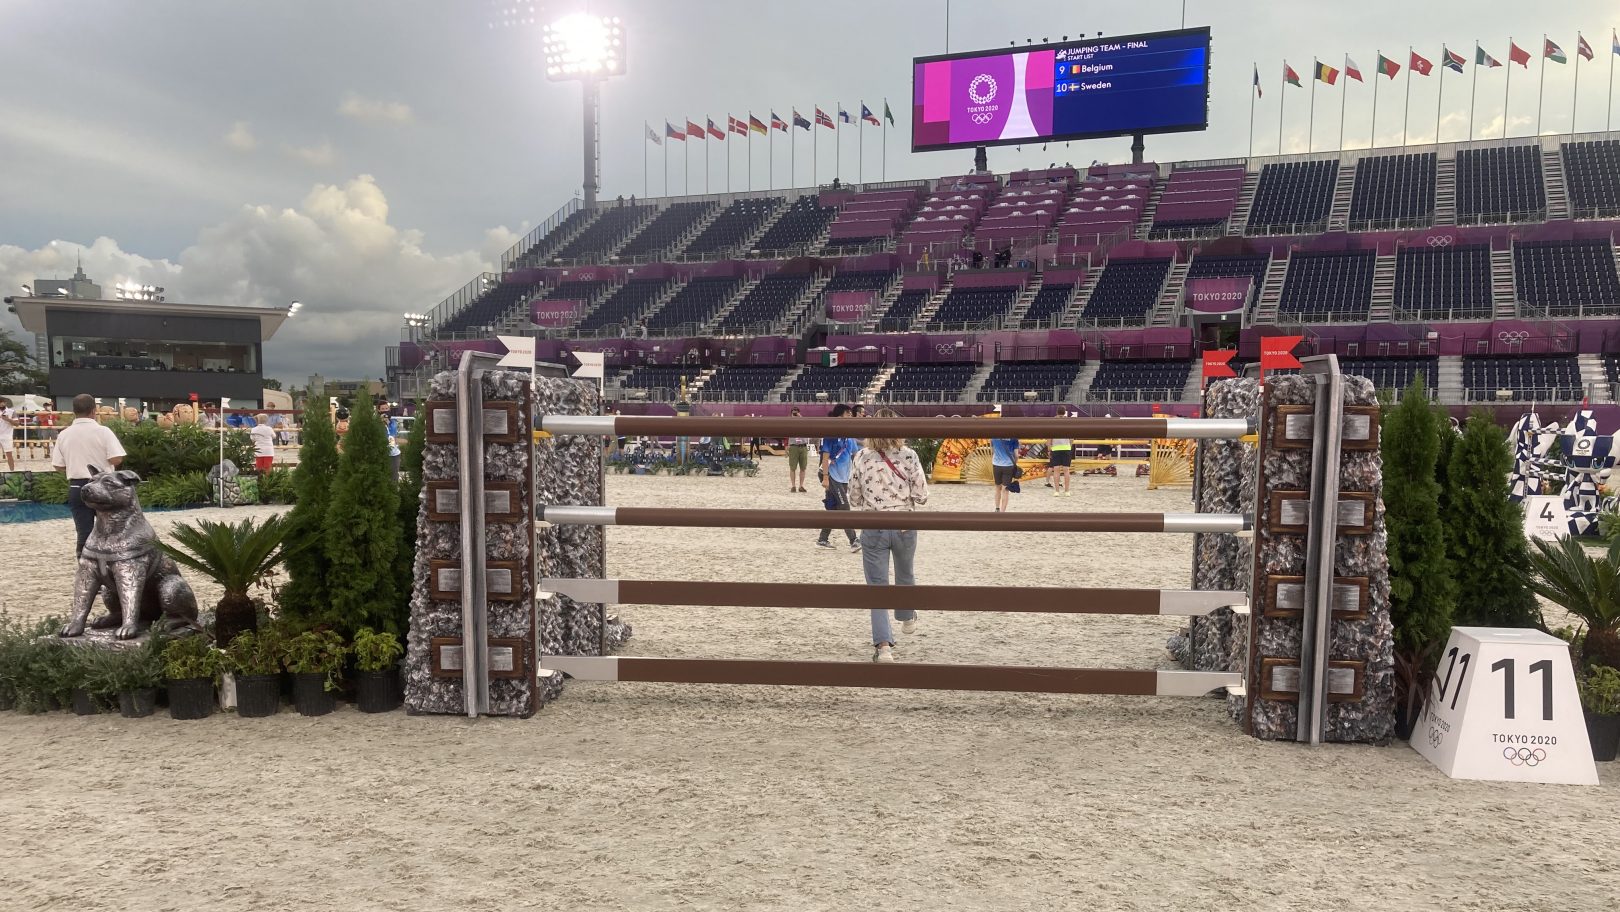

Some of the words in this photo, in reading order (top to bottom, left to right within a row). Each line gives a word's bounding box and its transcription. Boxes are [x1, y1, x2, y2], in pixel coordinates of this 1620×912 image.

[1067, 45, 1098, 55] JUMPING
[1100, 43, 1121, 52] TEAM
[1127, 41, 1148, 49] FINAL
[1059, 65, 1066, 75] 9
[1081, 63, 1113, 74] Belgium
[1056, 83, 1068, 93] 10
[1081, 81, 1112, 91] Sweden
[1193, 293, 1220, 301] TOKYO
[1221, 292, 1242, 300] 2020
[536, 311, 559, 320] TOKYO
[1540, 502, 1555, 522] 4
[1440, 647, 1471, 710] 11
[1491, 658, 1553, 721] 11
[1492, 733, 1528, 744] TOKYO
[1531, 735, 1557, 745] 2020
